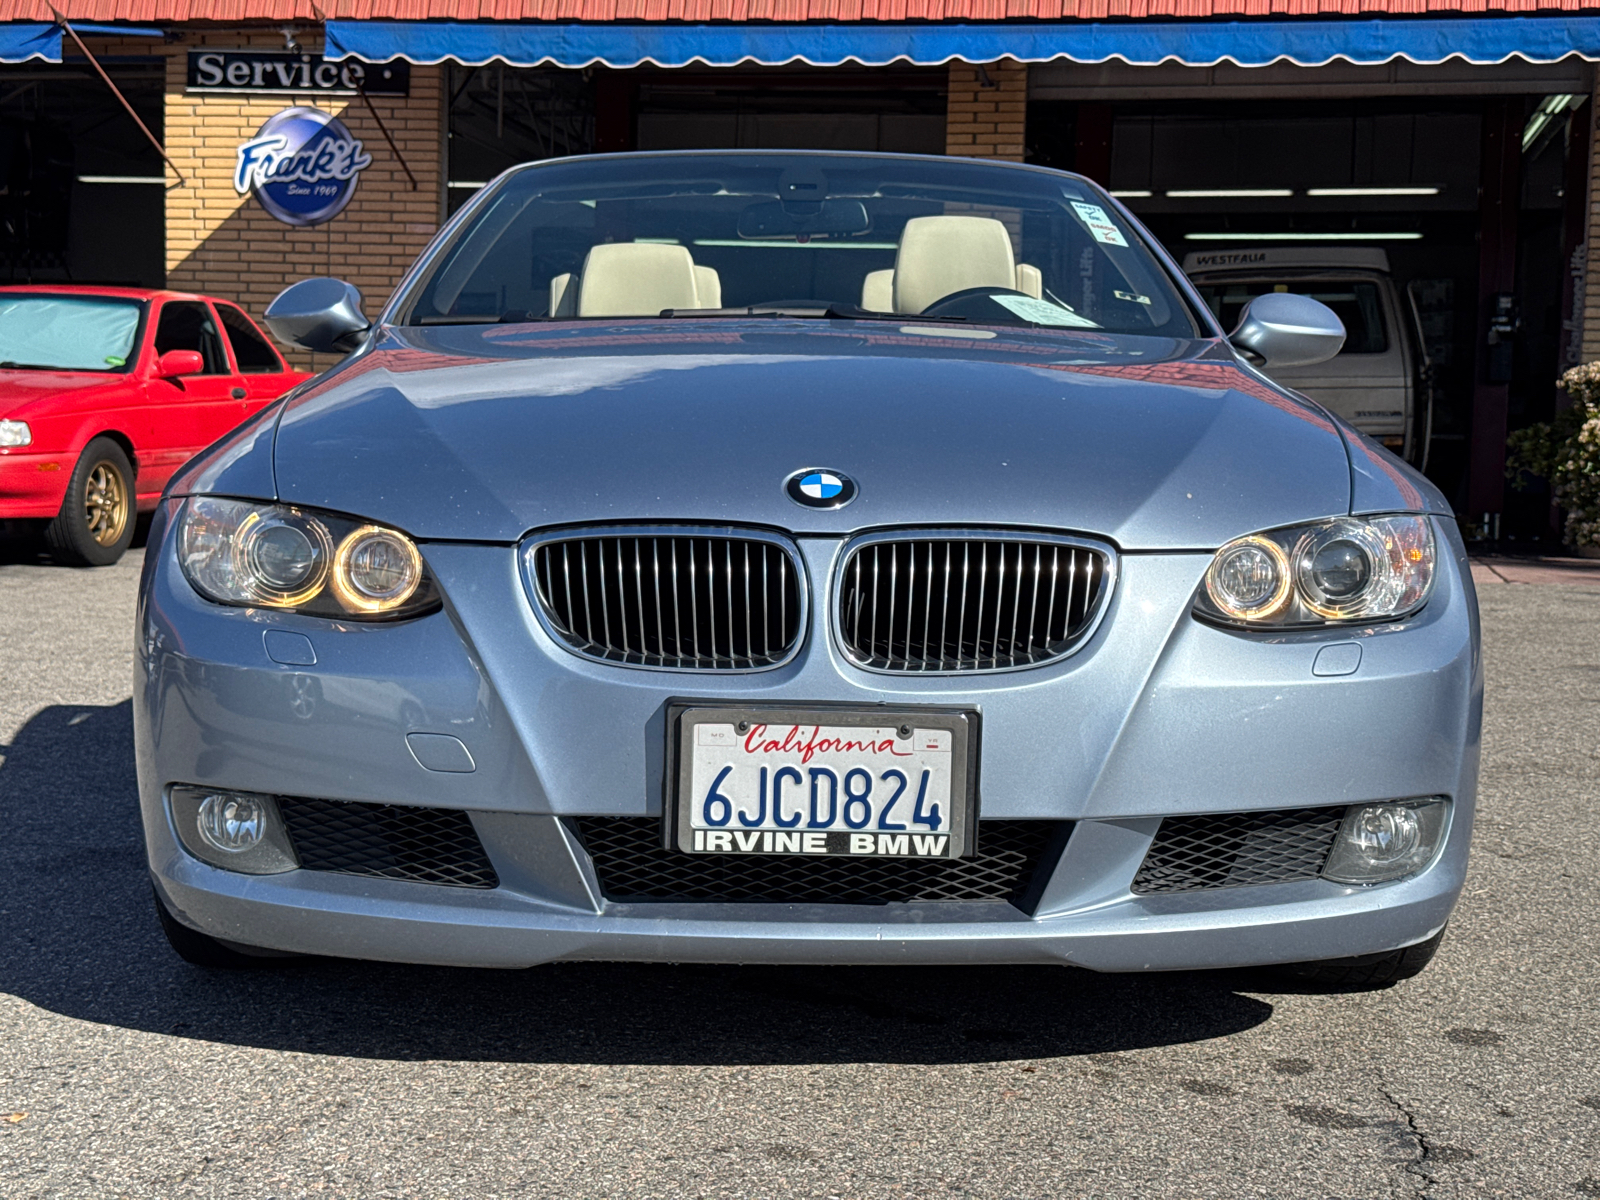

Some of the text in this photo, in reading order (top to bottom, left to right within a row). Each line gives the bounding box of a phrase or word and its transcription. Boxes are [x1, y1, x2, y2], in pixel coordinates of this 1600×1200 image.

[197, 54, 365, 88] Service
[234, 135, 372, 193] Frank's
[287, 184, 338, 197] Since 1969
[1196, 253, 1266, 264] WESTFALIA
[744, 724, 914, 764] California
[703, 766, 942, 831] 6JCD824
[694, 830, 948, 856] IRVINE BMW
